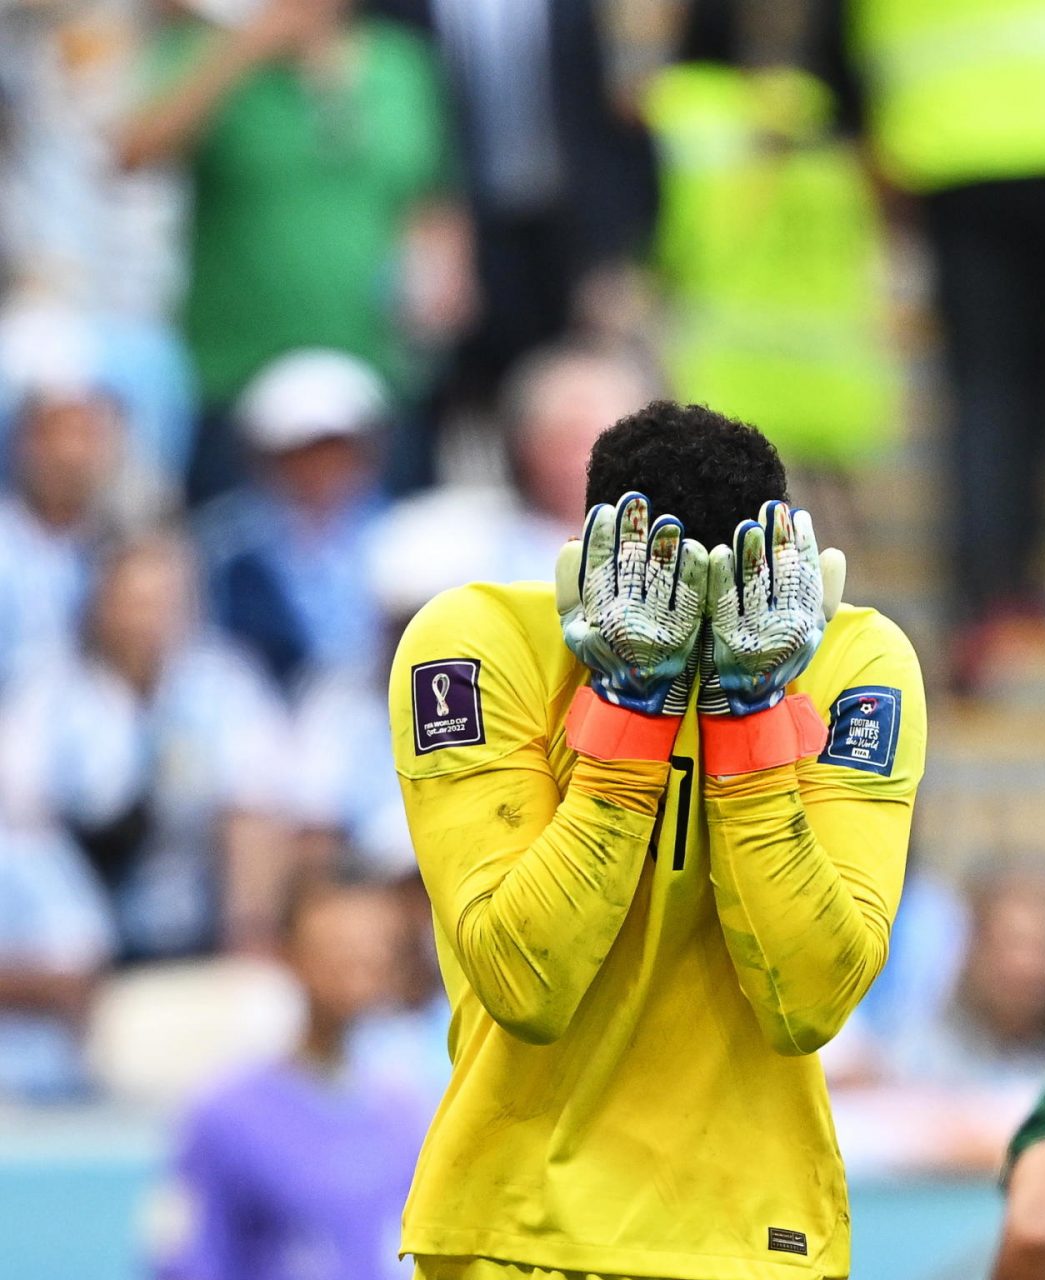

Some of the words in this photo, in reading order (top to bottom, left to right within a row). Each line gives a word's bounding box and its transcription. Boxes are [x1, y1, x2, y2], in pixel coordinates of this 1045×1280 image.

[434, 718, 455, 728] WORLD
[456, 717, 468, 725] CUP
[850, 718, 880, 729] FOOTBALL
[447, 724, 466, 733] 2022
[849, 727, 880, 740] UNITES
[846, 737, 858, 745] the
[858, 738, 879, 751] World
